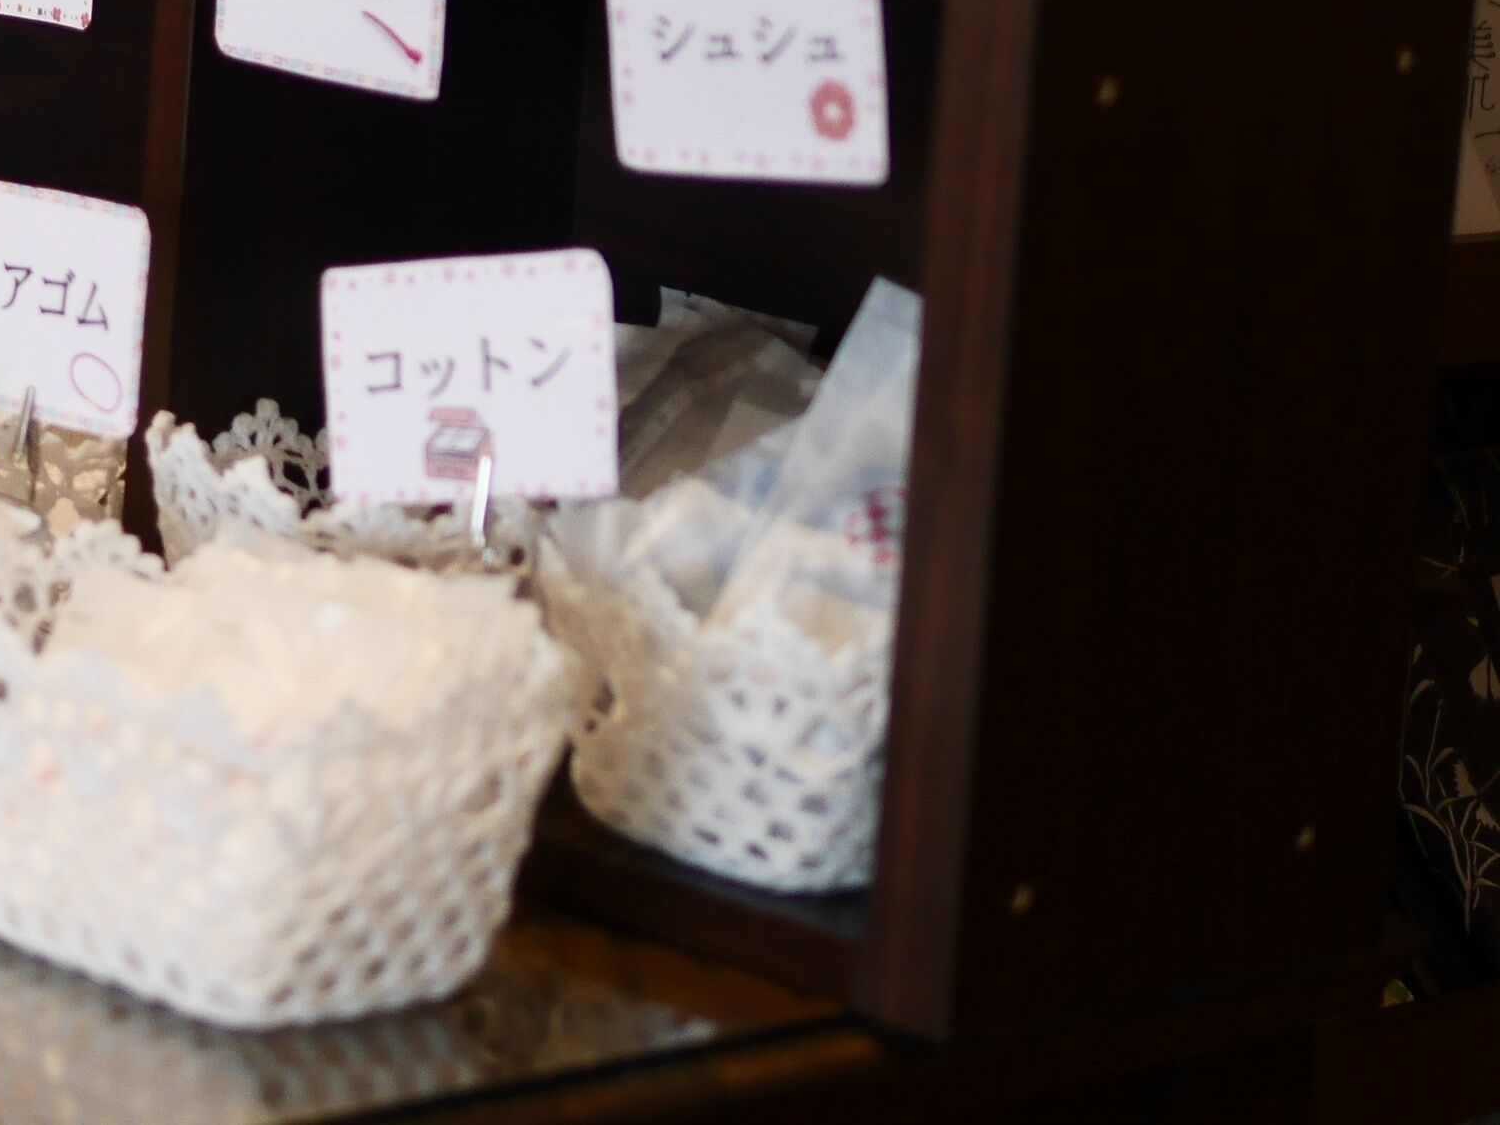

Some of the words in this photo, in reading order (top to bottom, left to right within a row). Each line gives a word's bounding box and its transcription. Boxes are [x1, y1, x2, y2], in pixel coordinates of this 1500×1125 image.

[652, 15, 846, 64] シュシュ
[365, 335, 572, 398] コットン
